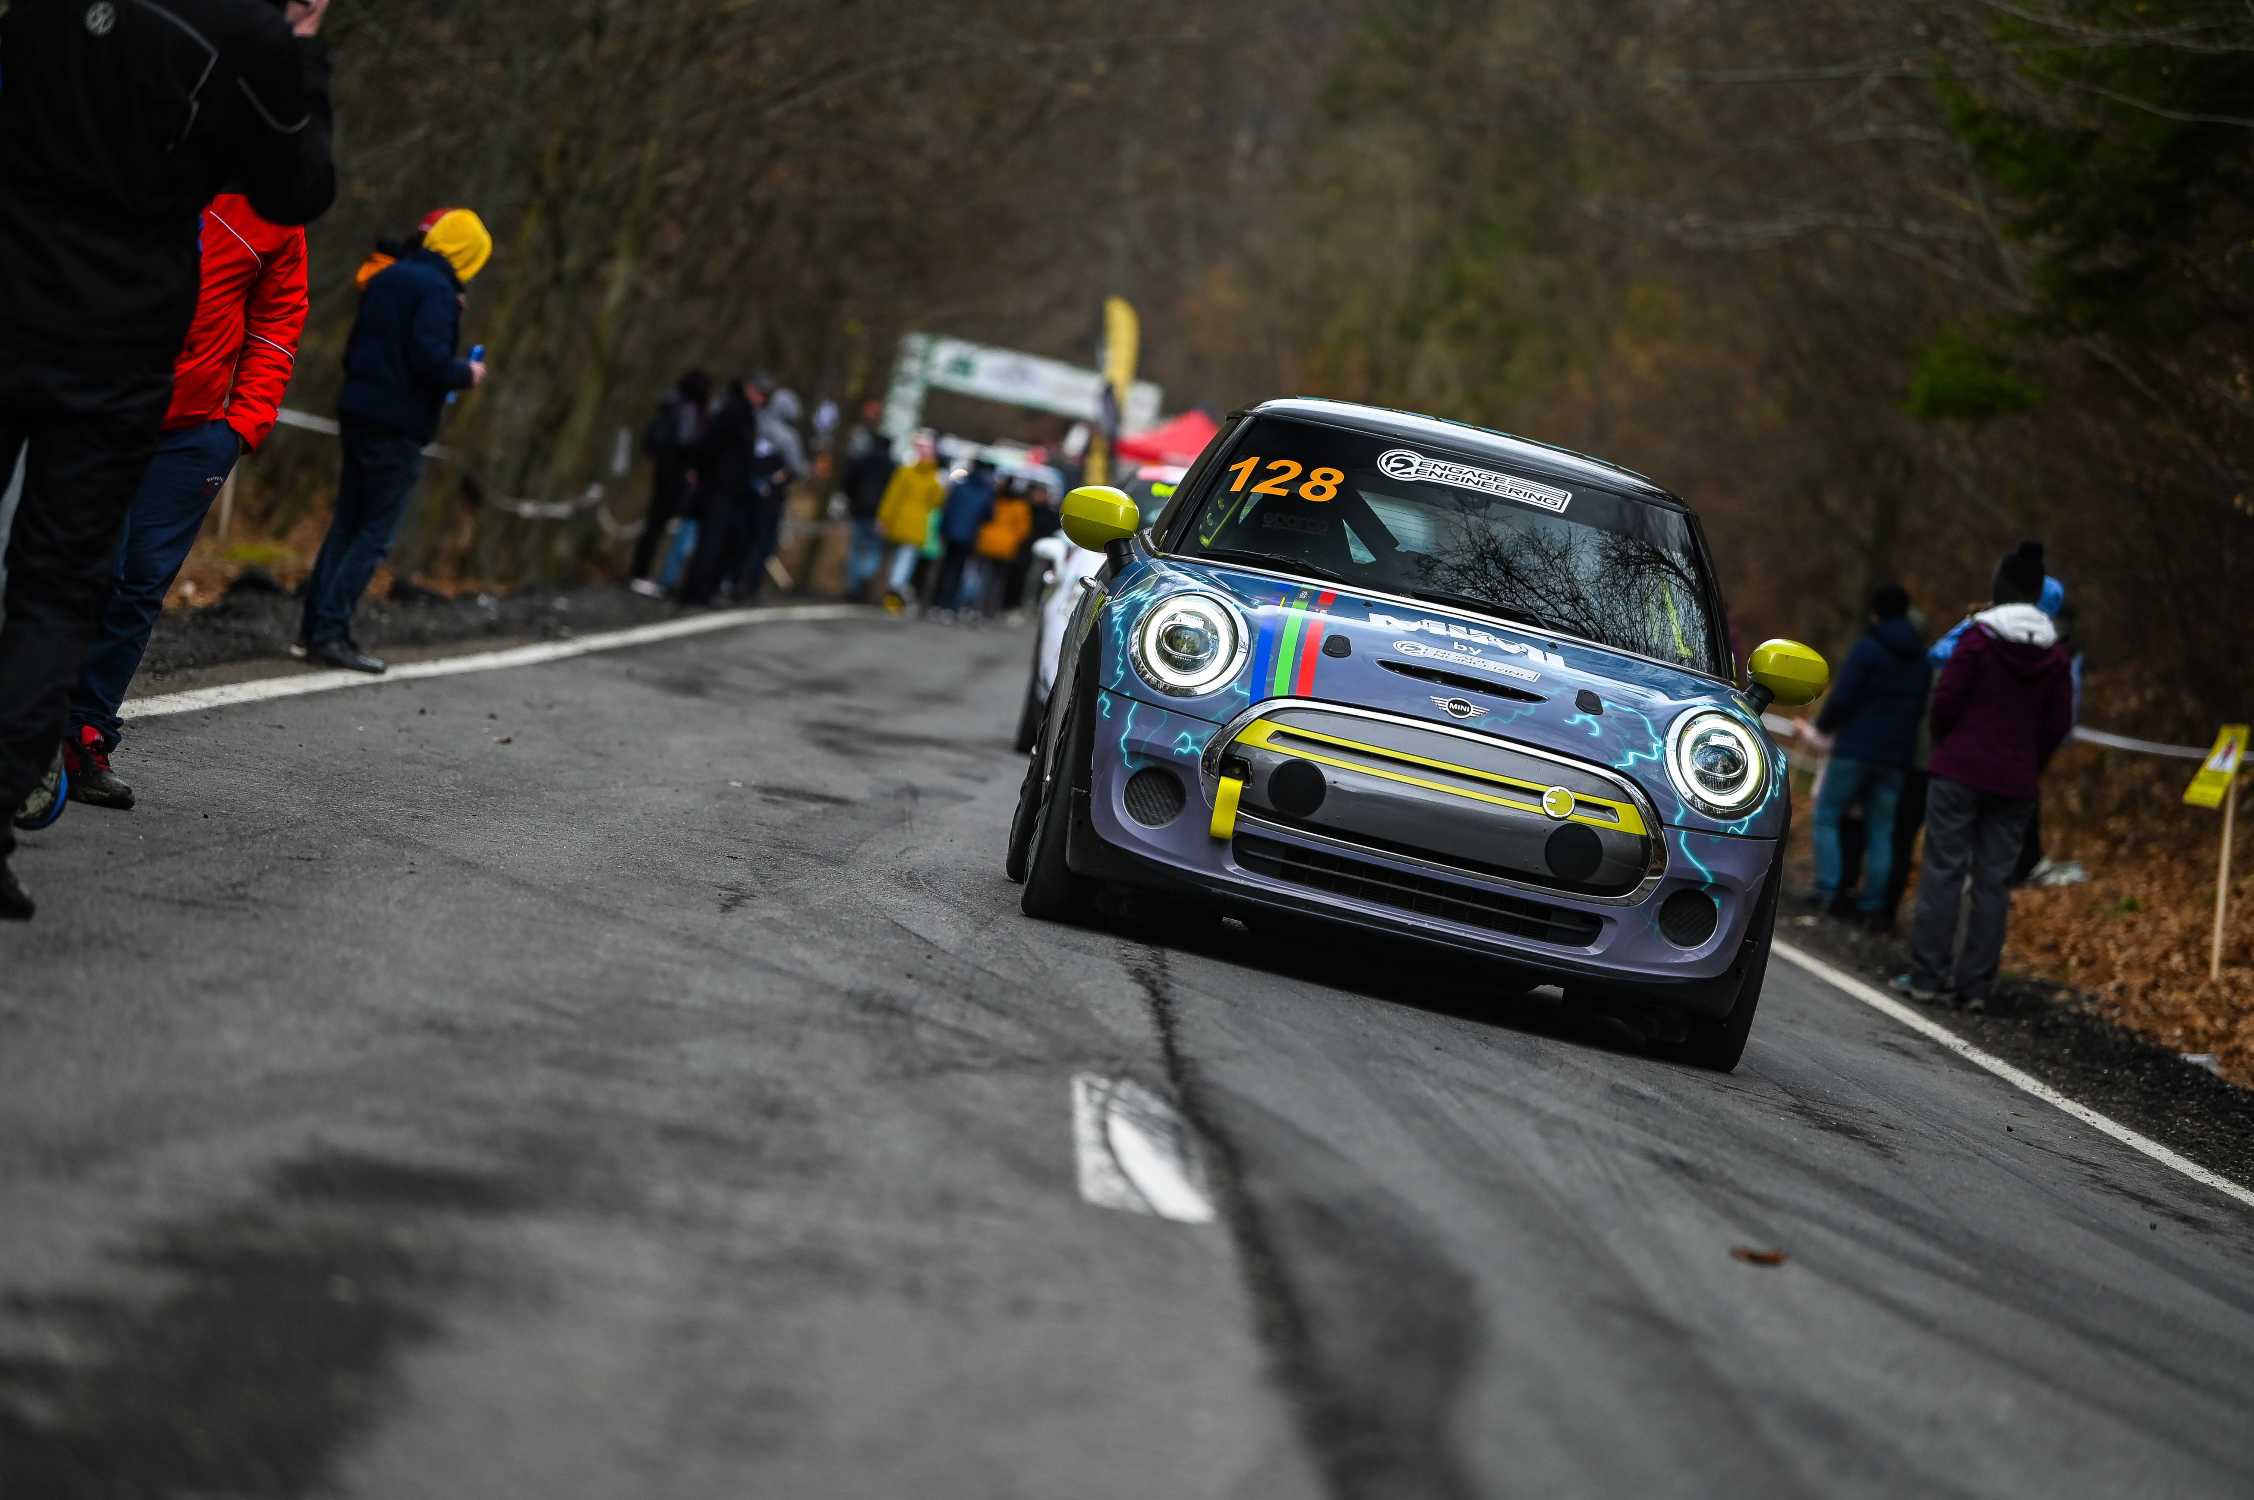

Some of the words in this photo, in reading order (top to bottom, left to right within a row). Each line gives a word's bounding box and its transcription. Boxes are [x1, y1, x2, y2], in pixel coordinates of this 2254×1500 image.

[1229, 456, 1345, 503] 128
[1418, 460, 1509, 484] ENGAGE
[1414, 467, 1559, 507] ENGINEERING
[1453, 641, 1483, 656] by
[1448, 702, 1470, 713] MINI
